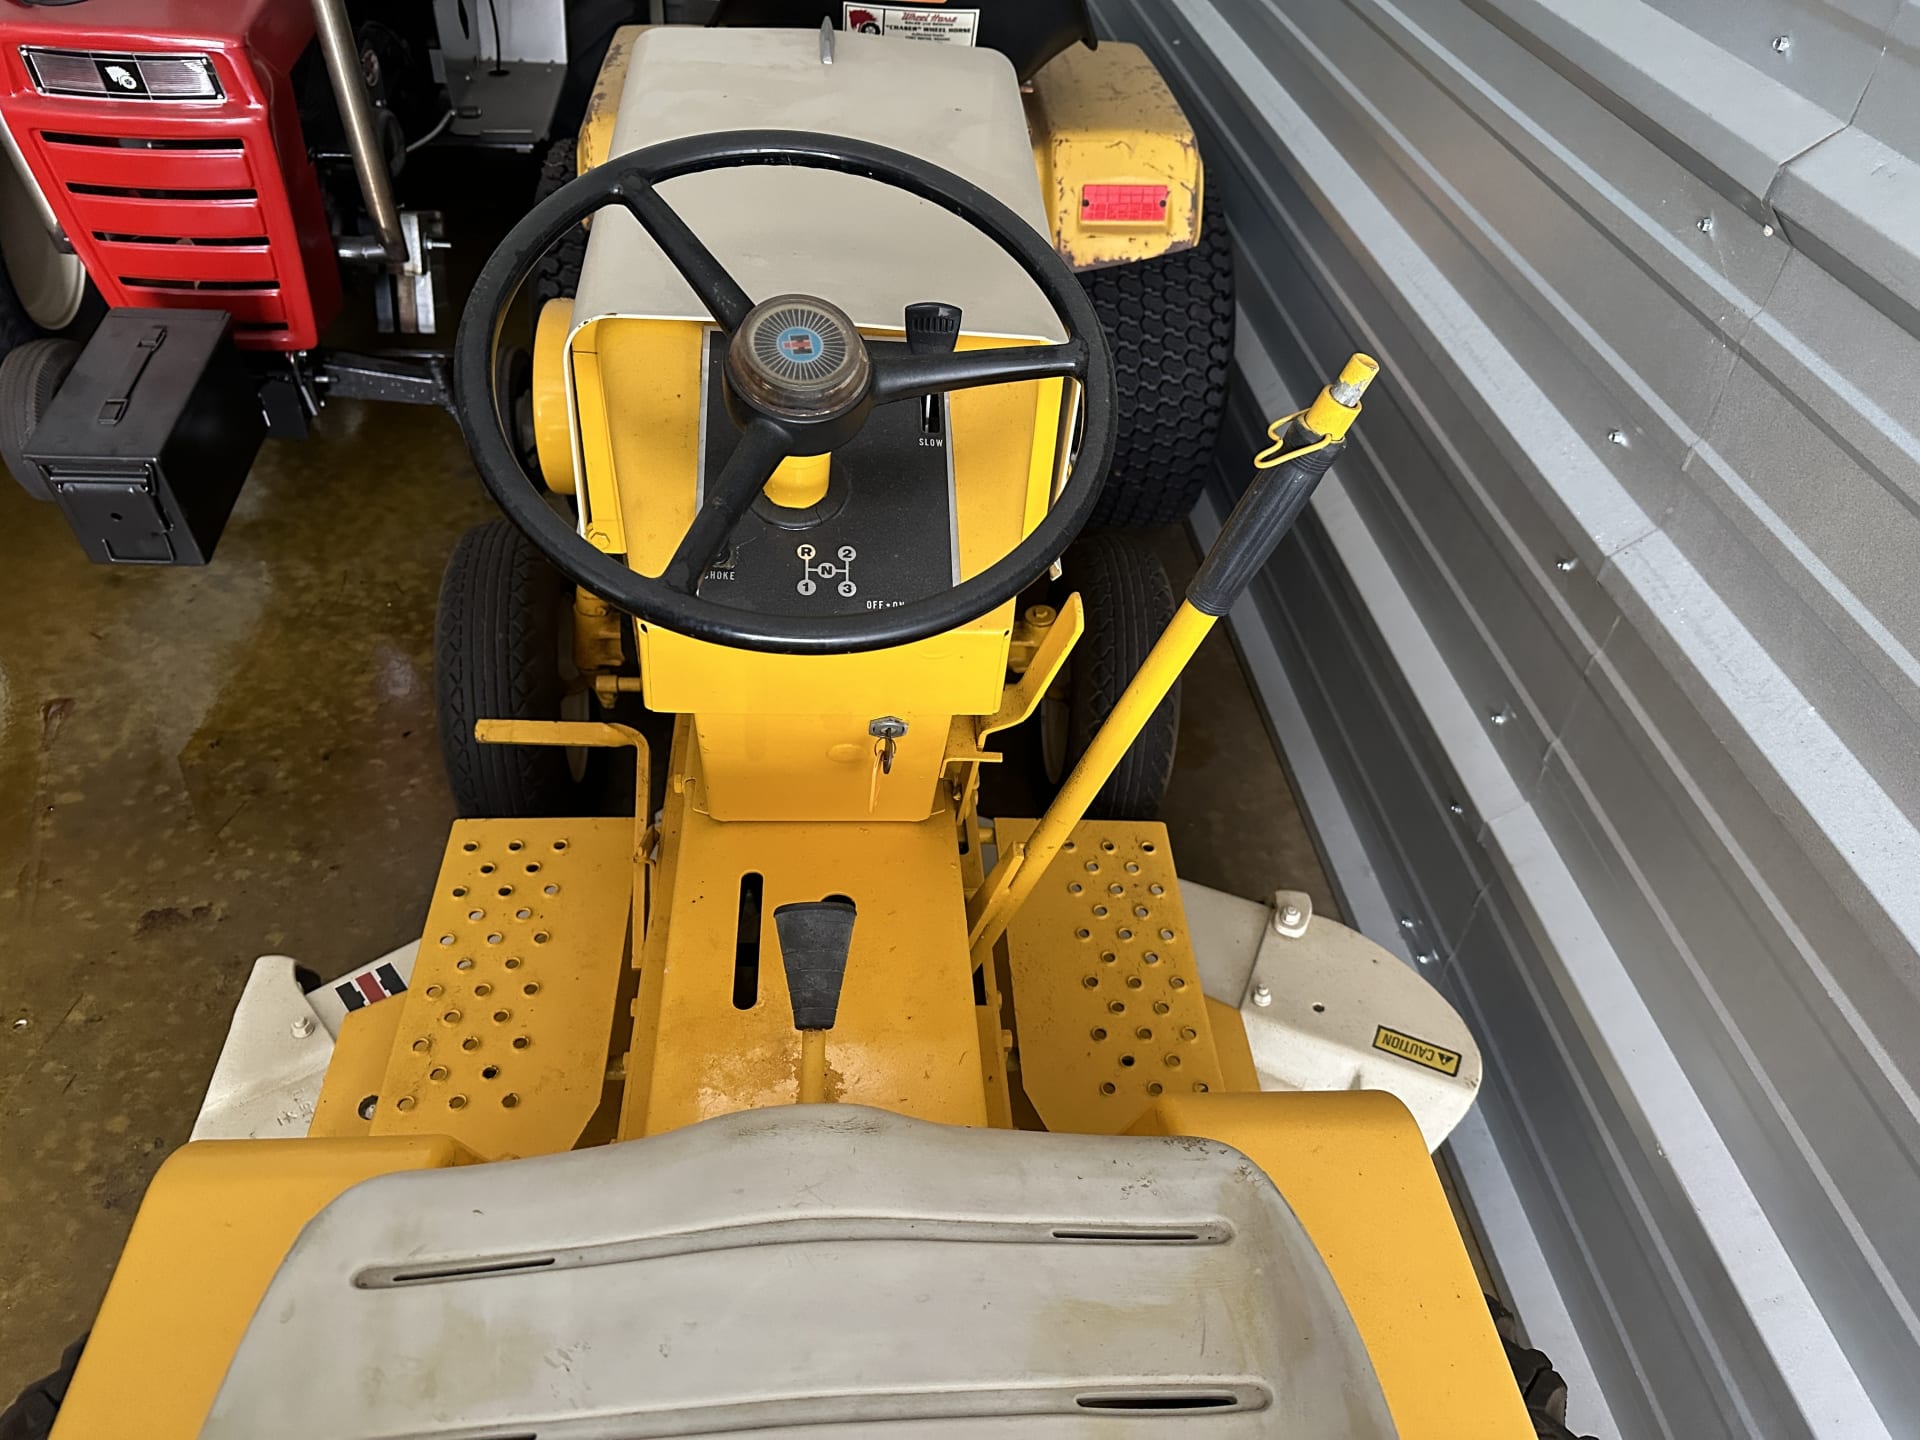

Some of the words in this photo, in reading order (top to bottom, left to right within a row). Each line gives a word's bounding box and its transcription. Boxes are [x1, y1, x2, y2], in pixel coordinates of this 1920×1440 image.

[901, 11, 930, 22] Wheel
[919, 438, 943, 447] SLOW
[801, 547, 812, 557] R
[842, 549, 852, 559] 2
[821, 566, 833, 576] N
[843, 584, 852, 594] 3
[866, 600, 884, 610] OFF
[1382, 1033, 1435, 1061] CAUTION
